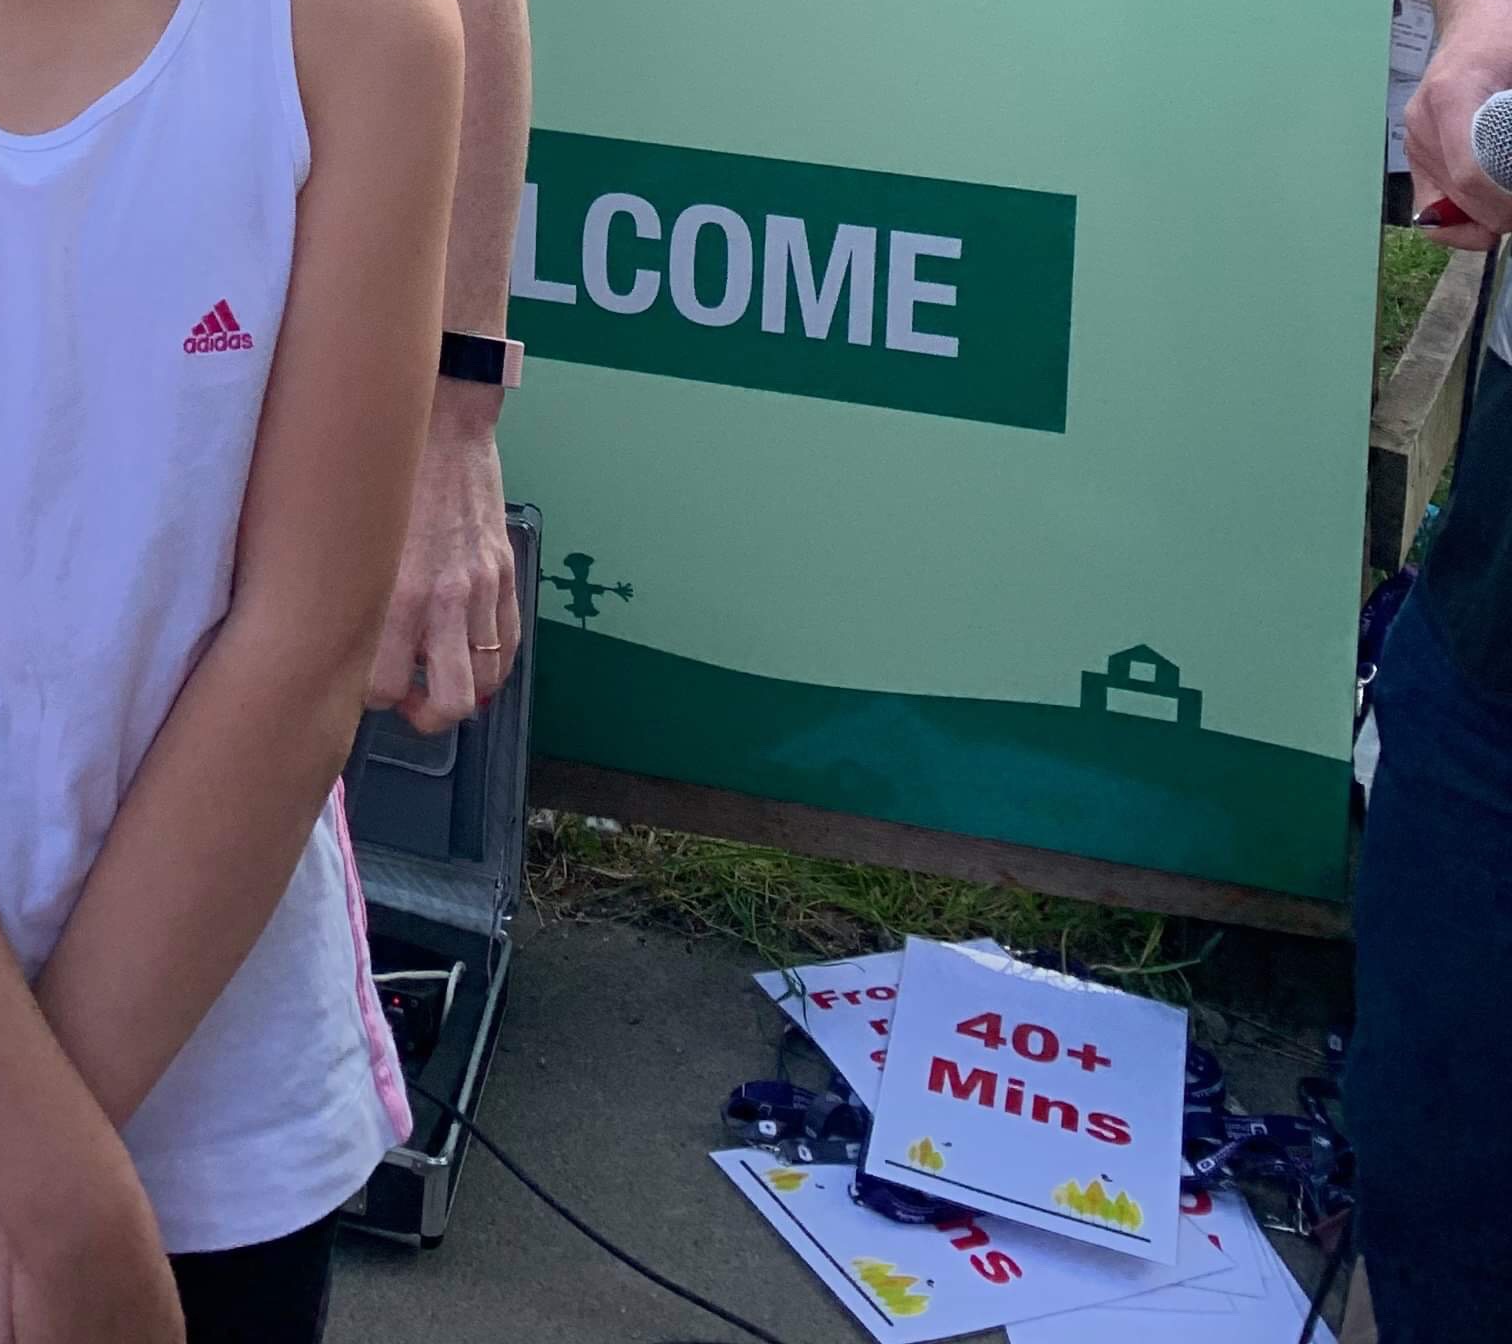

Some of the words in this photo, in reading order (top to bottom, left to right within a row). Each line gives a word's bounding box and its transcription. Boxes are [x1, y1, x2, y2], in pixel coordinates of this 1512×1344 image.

[510, 181, 963, 358] LCOME
[182, 331, 254, 354] adidas
[808, 983, 900, 1009] Fro
[955, 1011, 1112, 1072] 40+
[926, 1056, 1133, 1146] Mins
